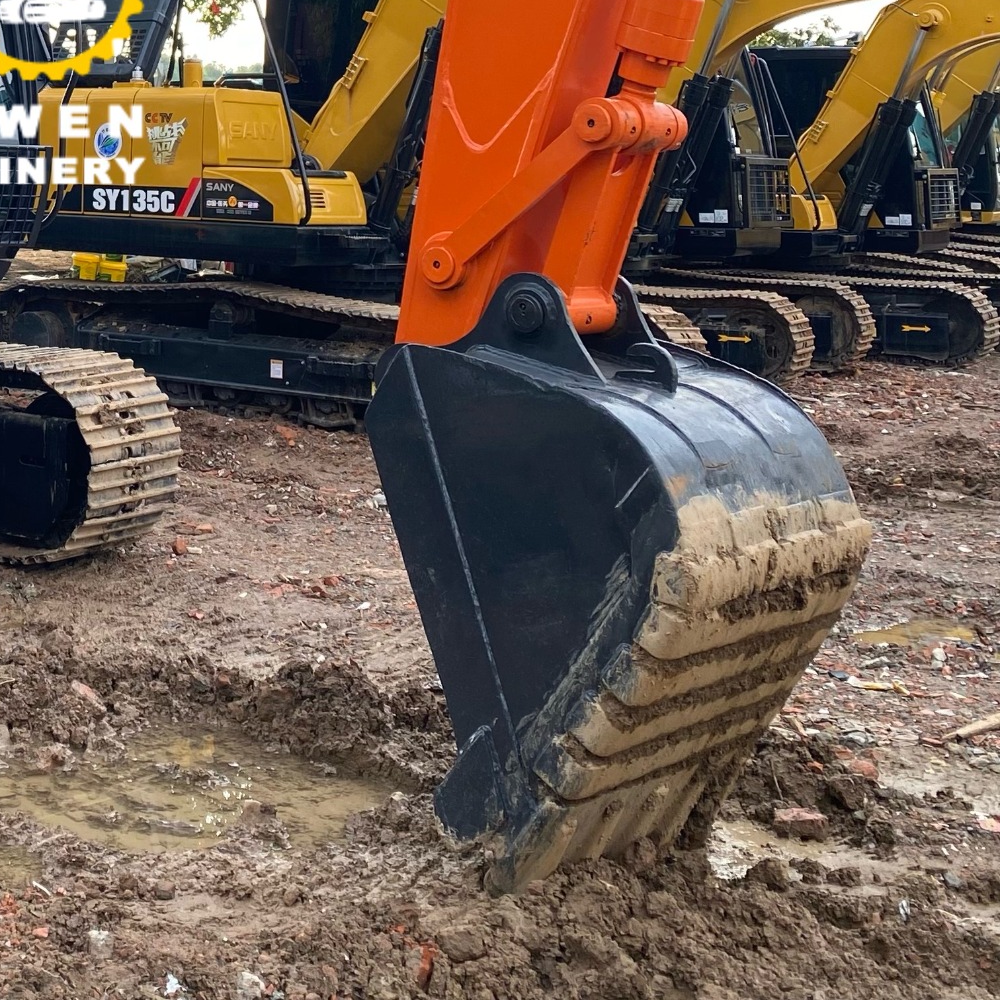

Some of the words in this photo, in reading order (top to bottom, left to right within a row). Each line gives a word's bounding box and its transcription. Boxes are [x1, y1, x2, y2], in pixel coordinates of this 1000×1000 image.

[145, 112, 173, 124] CCTV
[206, 182, 234, 192] SANY
[92, 187, 175, 213] SY135C
